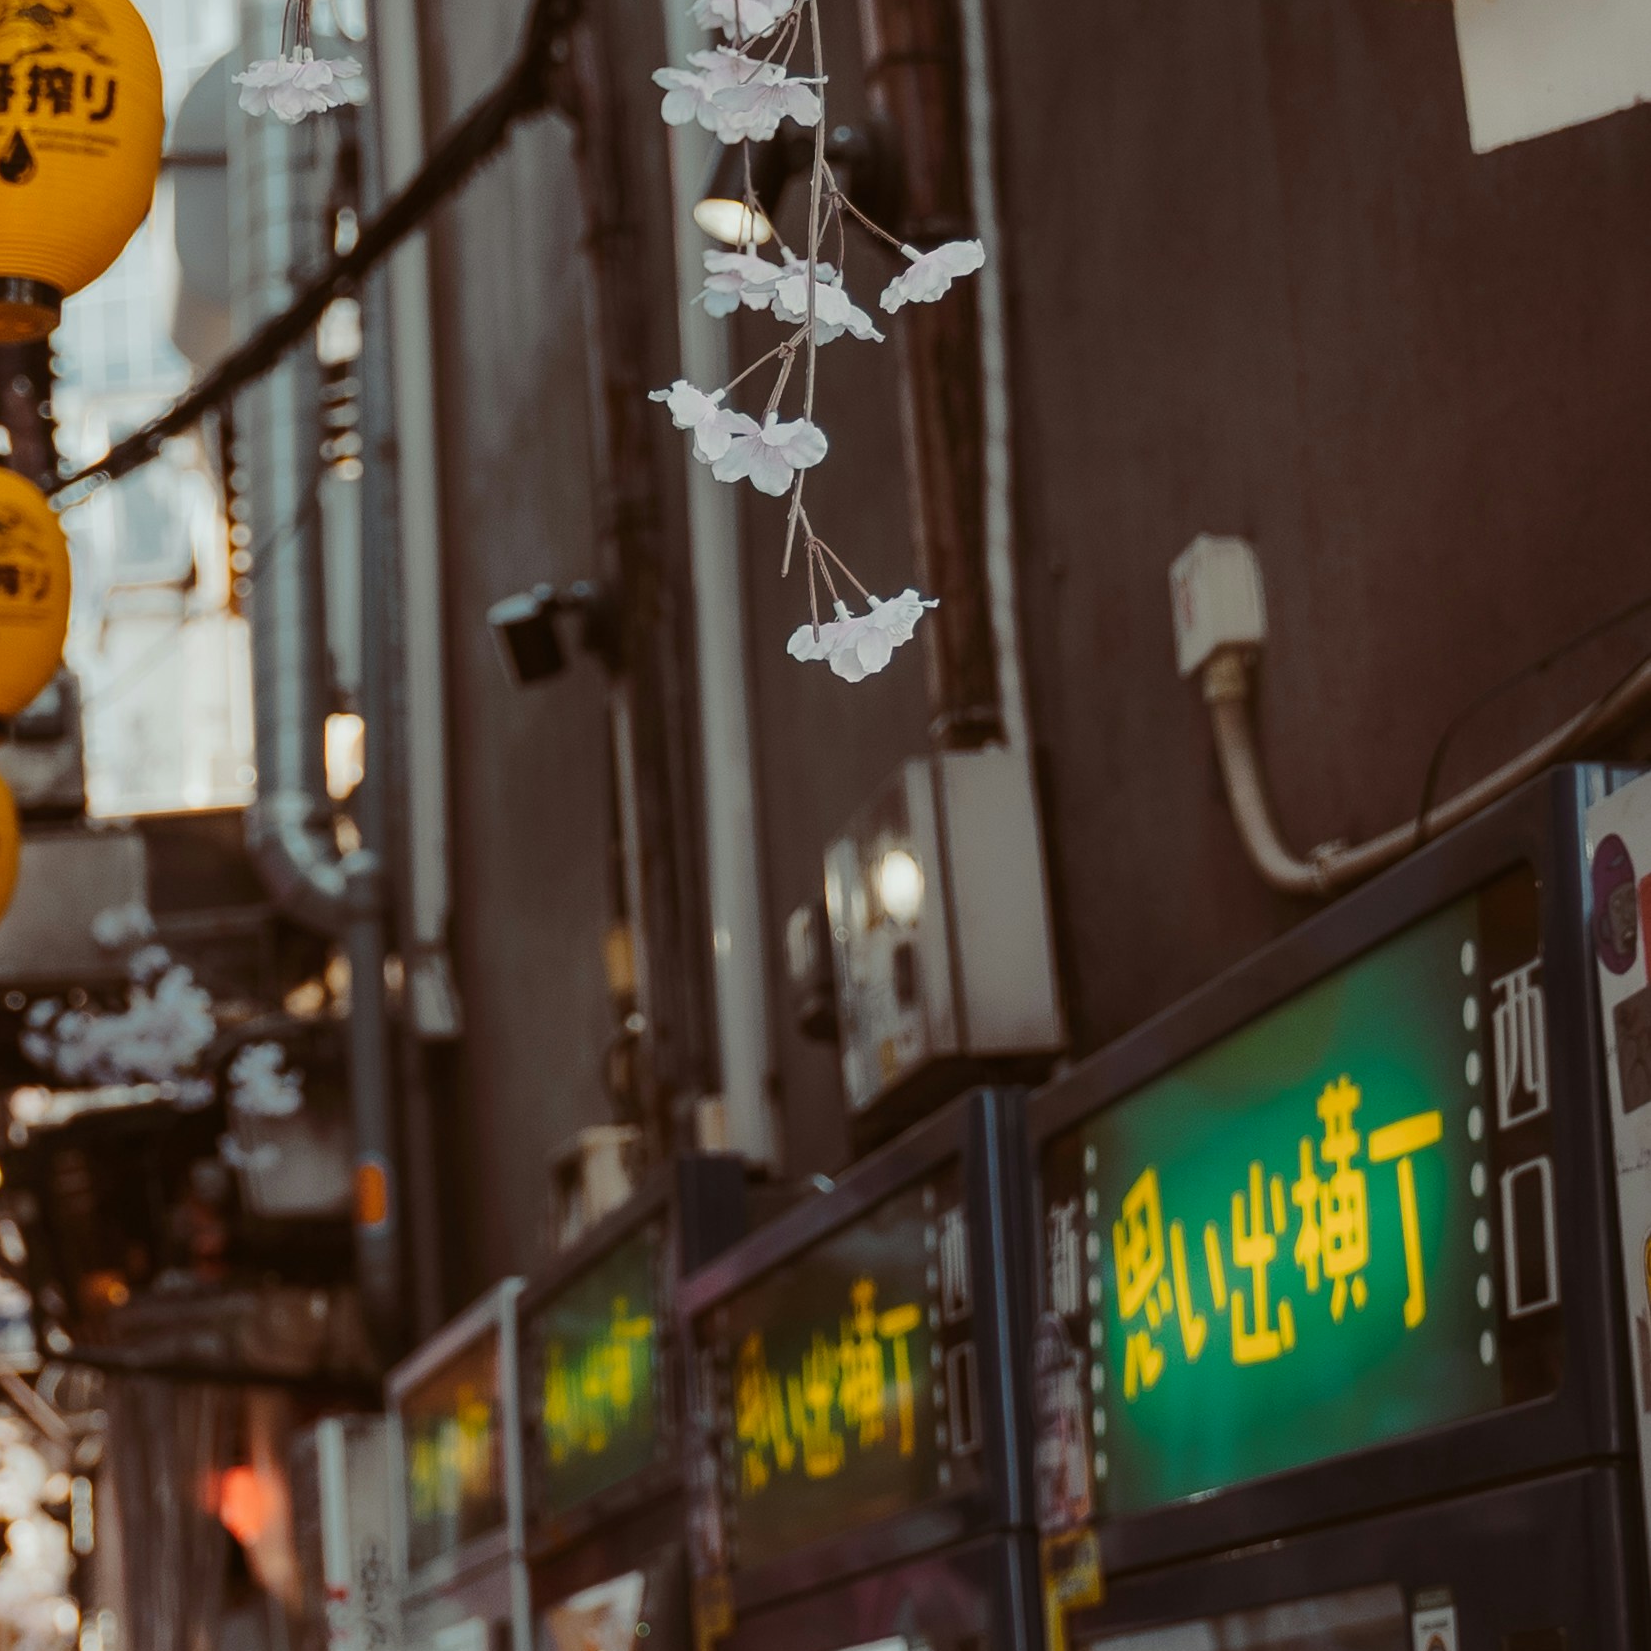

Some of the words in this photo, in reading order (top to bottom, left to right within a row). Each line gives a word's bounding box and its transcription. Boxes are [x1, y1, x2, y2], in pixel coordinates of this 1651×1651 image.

[1112, 1073, 1443, 1401] 思い出横丁
[1490, 958, 1561, 1321] 西口
